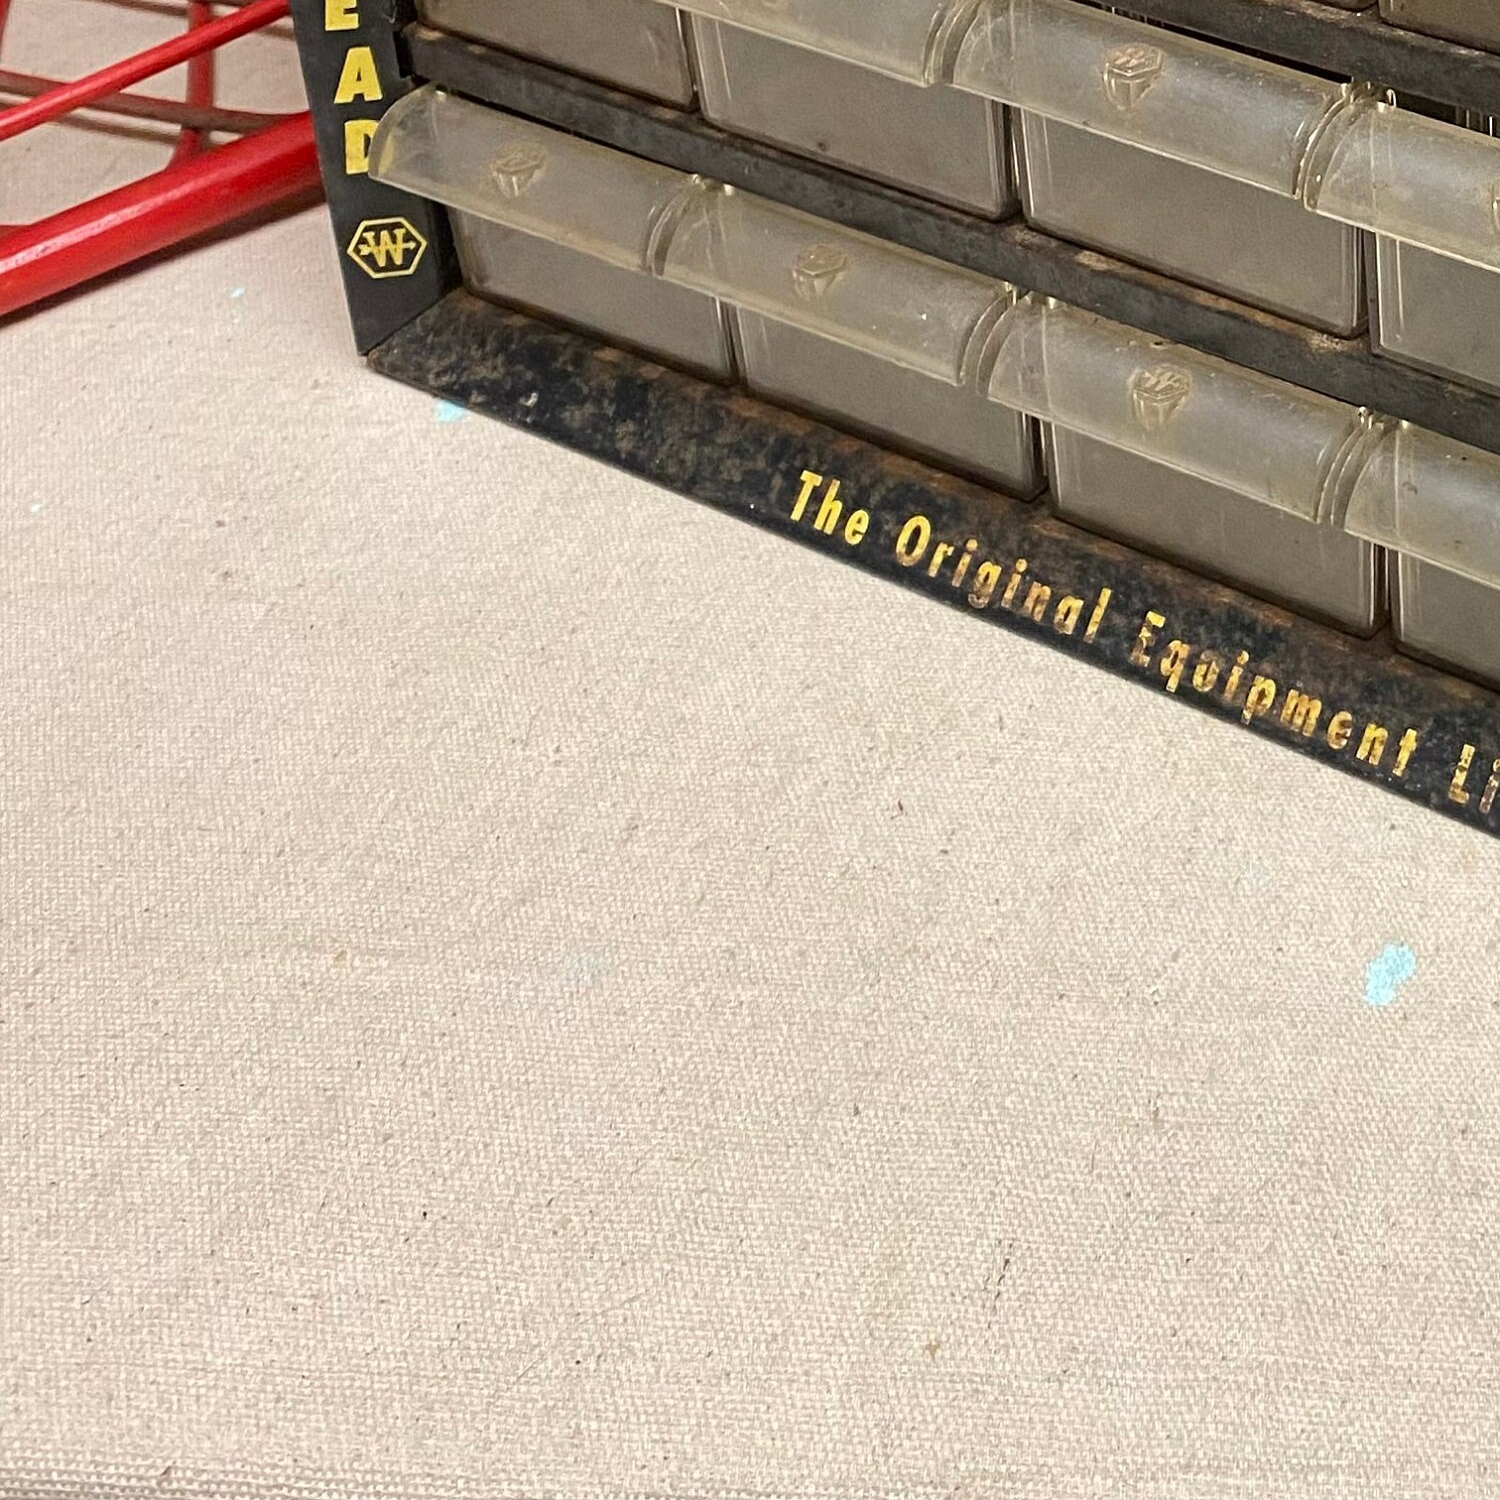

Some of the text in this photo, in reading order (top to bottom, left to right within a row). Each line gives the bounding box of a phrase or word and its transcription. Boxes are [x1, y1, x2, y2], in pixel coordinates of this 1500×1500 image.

[790, 469, 870, 546] The
[895, 515, 1112, 644] Original
[1129, 610, 1418, 778] Equipment
